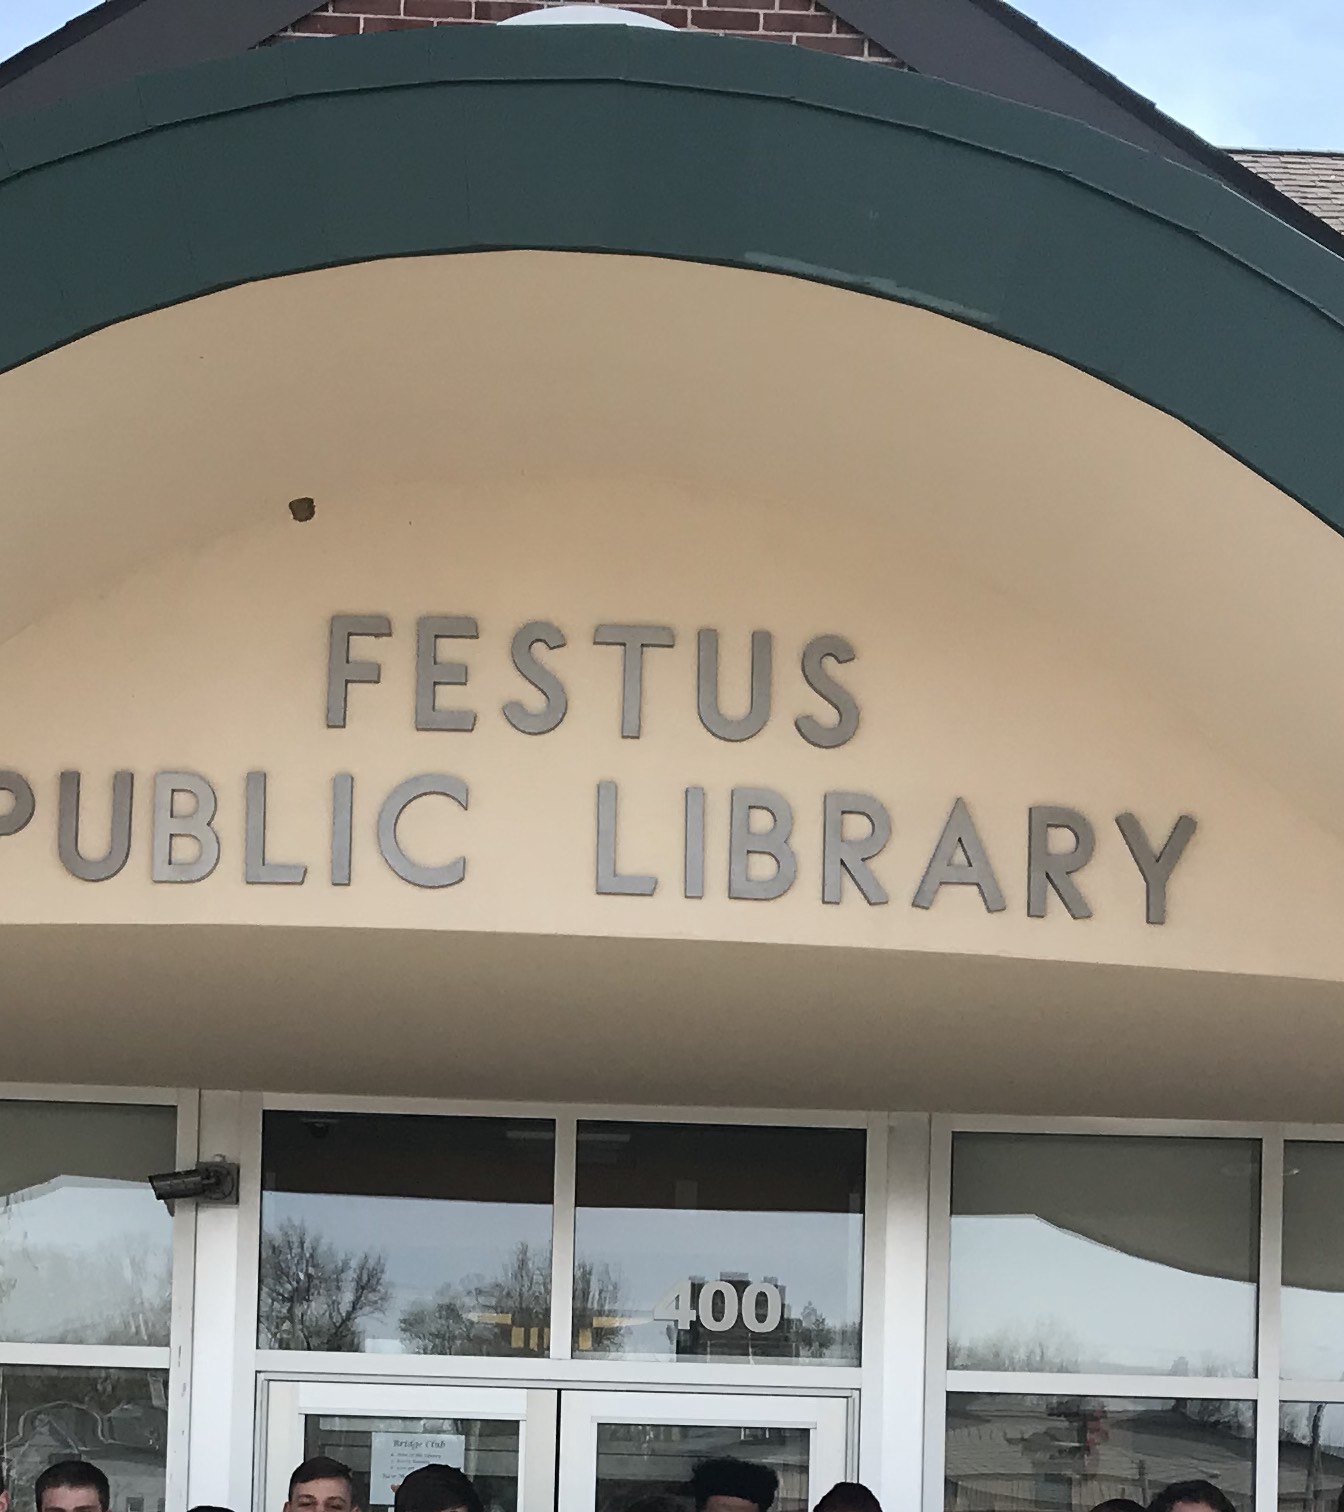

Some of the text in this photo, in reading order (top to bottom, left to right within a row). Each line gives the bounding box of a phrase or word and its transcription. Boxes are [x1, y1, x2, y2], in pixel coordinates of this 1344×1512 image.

[325, 613, 861, 749] FESTUS
[594, 779, 1197, 926] LIBRARY
[653, 1279, 782, 1333] 400
